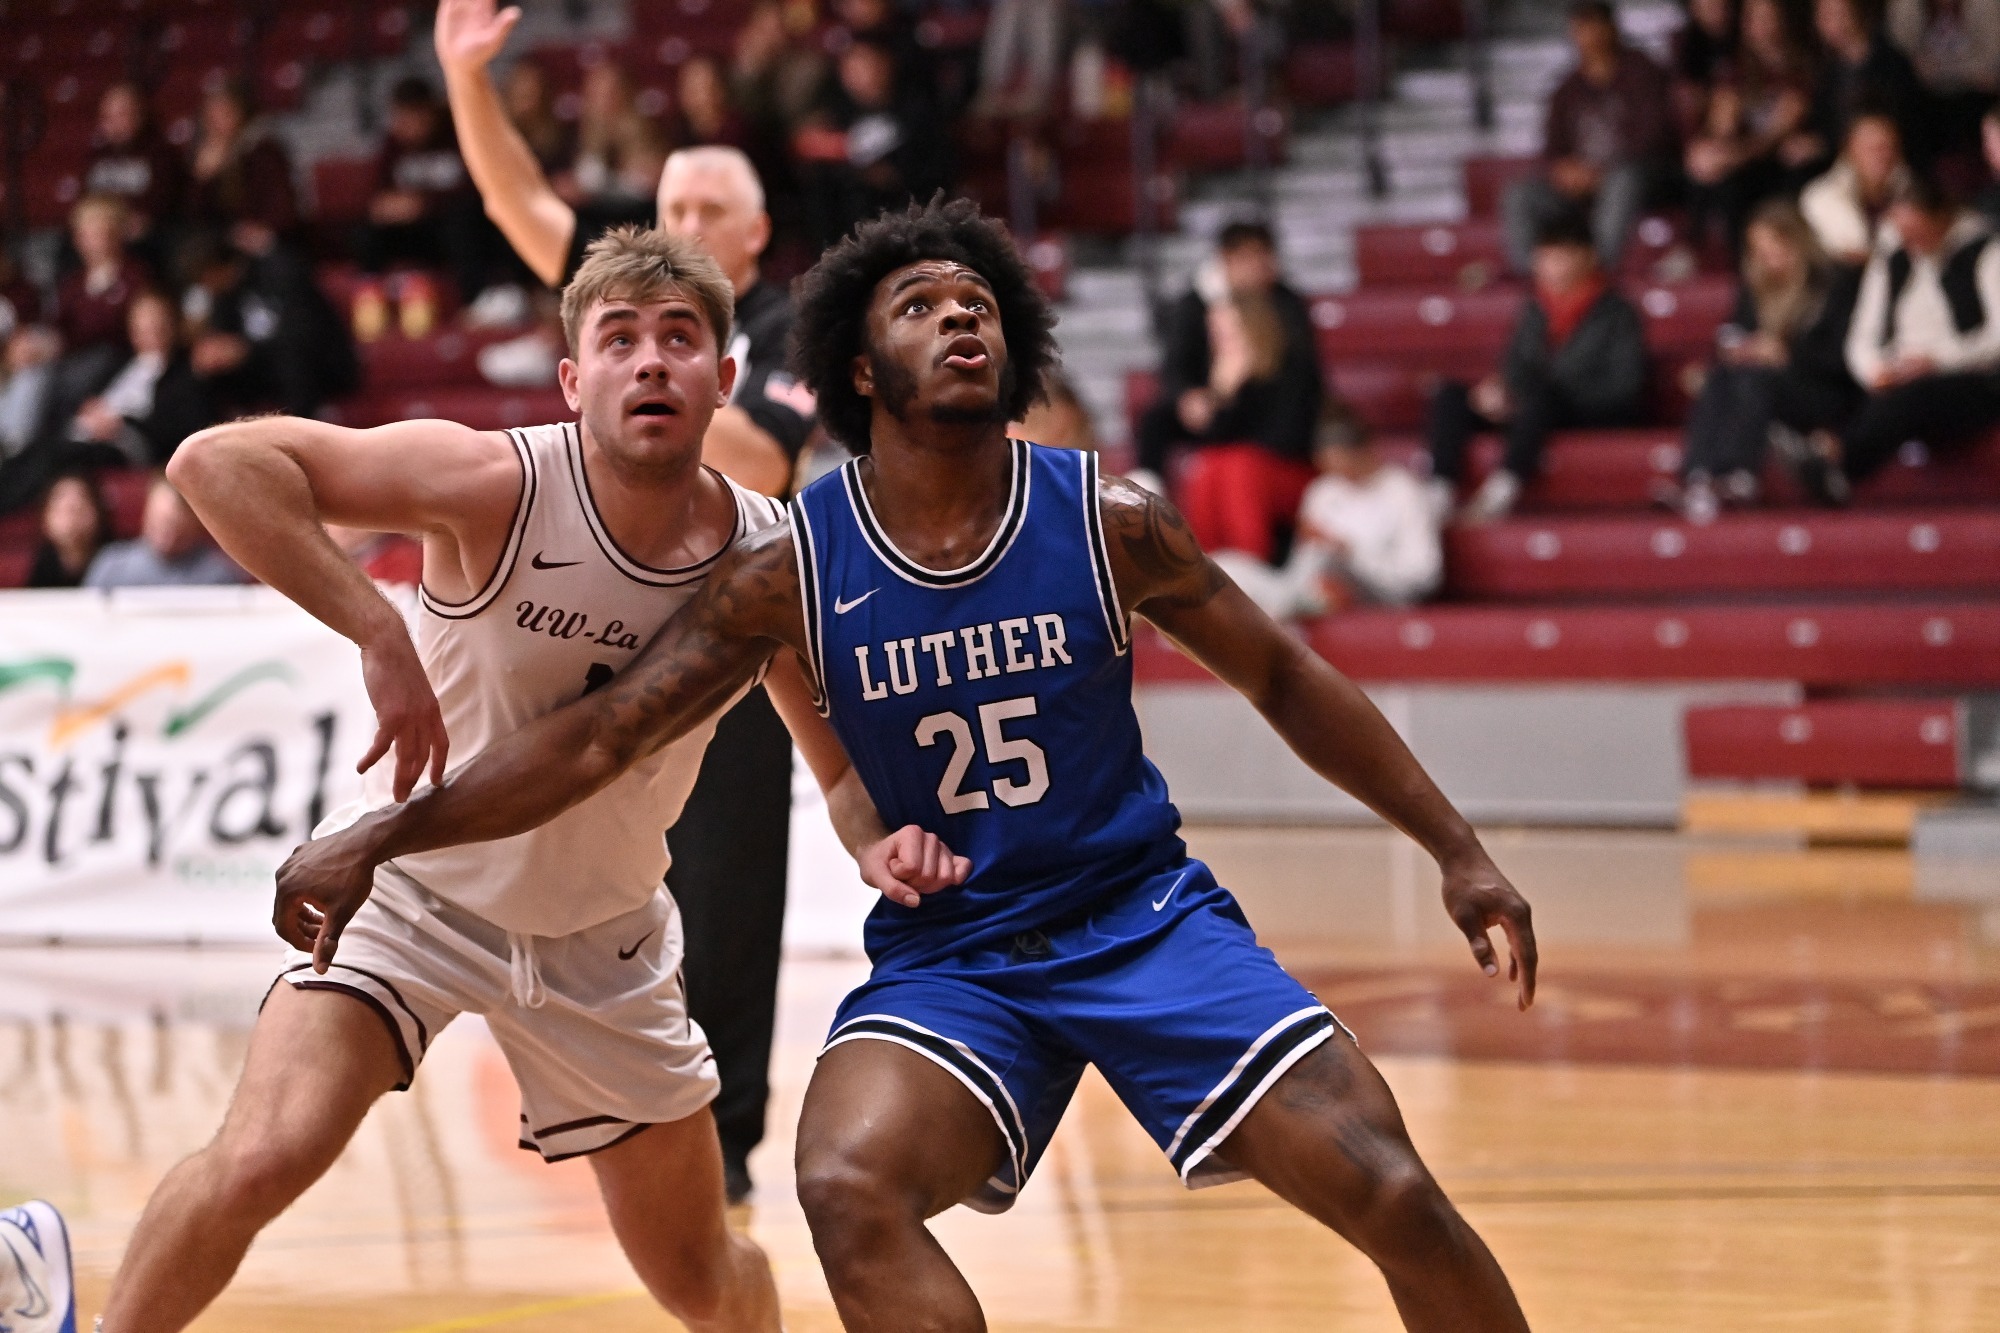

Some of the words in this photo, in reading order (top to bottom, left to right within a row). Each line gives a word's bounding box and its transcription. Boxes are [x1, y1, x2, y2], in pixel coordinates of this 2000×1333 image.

[516, 600, 640, 650] UW-La
[853, 612, 1073, 702] LUTHER
[913, 695, 1050, 815] 25
